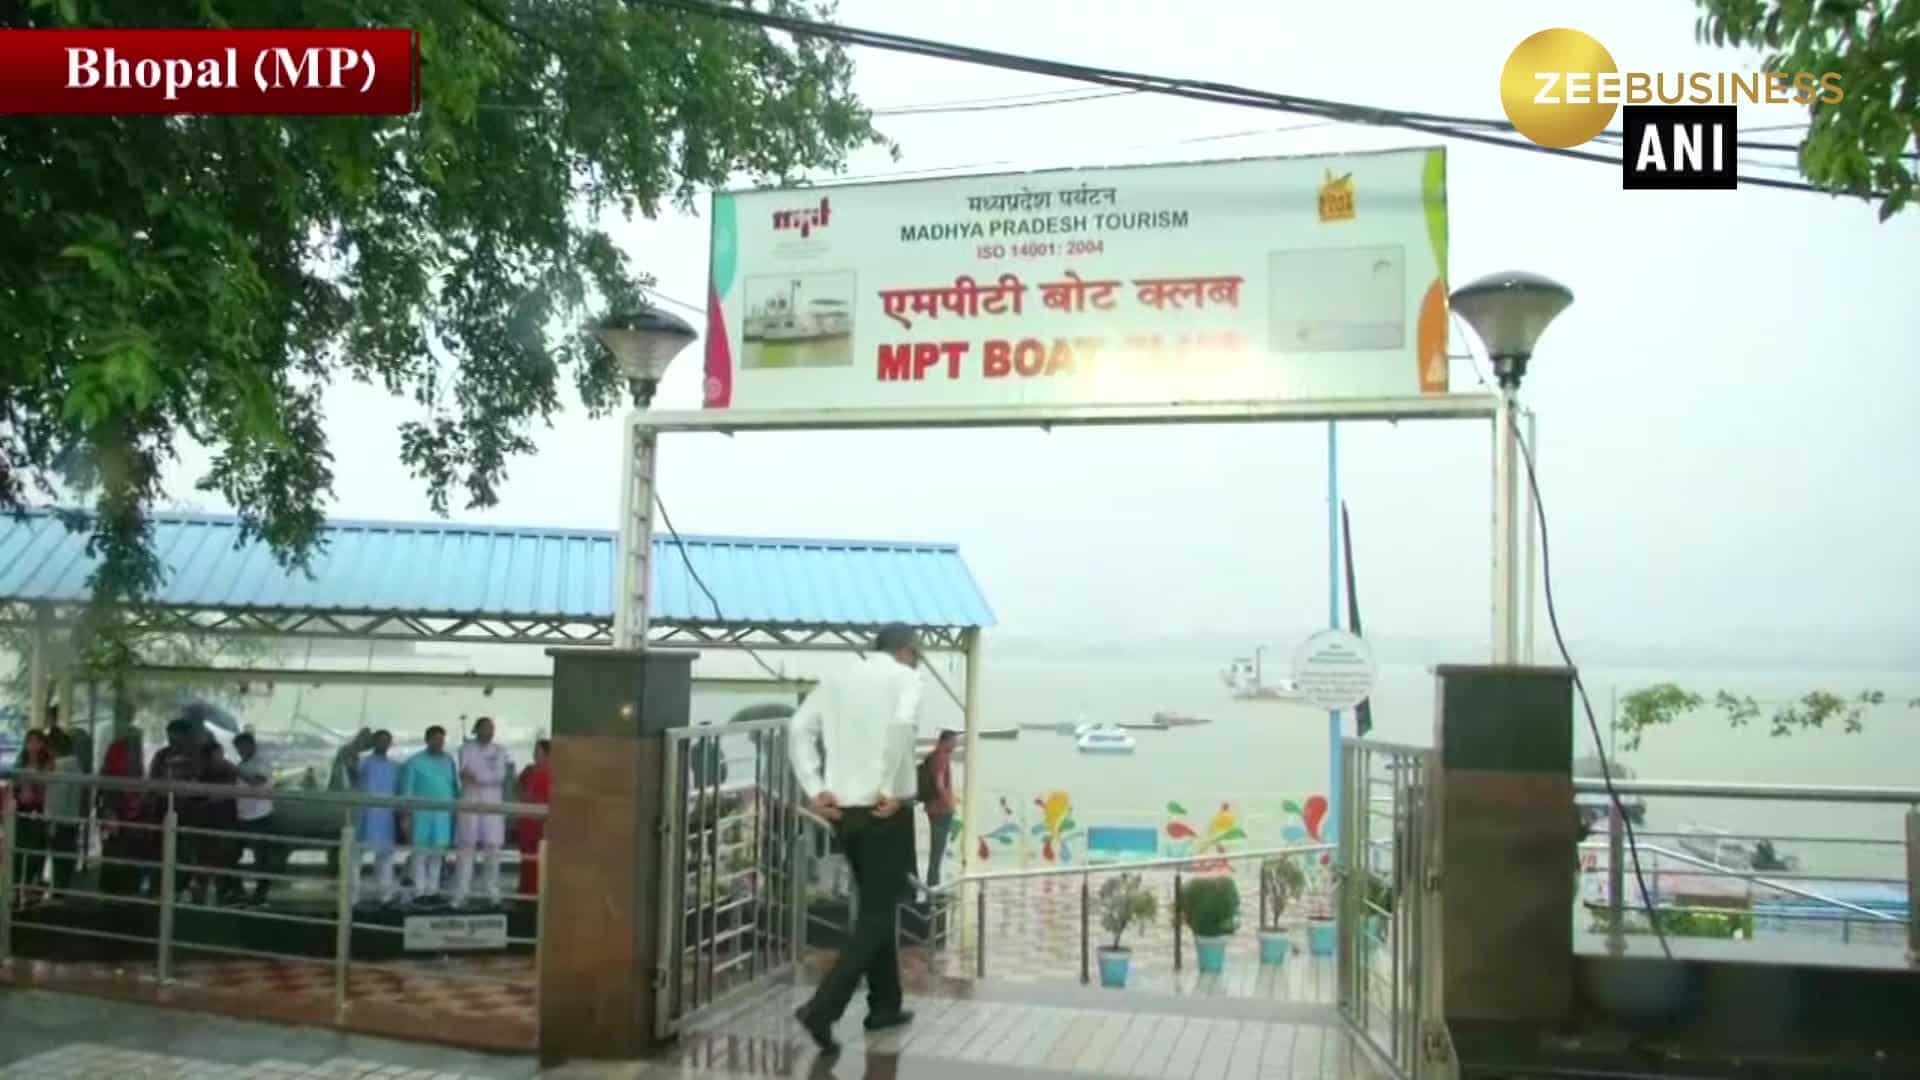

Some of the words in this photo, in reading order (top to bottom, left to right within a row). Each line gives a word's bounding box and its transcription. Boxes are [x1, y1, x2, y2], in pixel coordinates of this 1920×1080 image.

[967, 186, 1052, 212] मध्यप्रदेश
[1058, 183, 1117, 207] पर्यटन
[900, 223, 984, 242] MADHYA
[989, 215, 1087, 237] PRADESH
[1093, 210, 1189, 230] TOURISM
[976, 245, 1005, 260] ISO
[1067, 239, 1104, 256] 2004
[877, 273, 1028, 330] एमपीटी
[1037, 270, 1123, 314] बोट
[1131, 275, 1245, 310] क्लब
[877, 341, 970, 381] MPT
